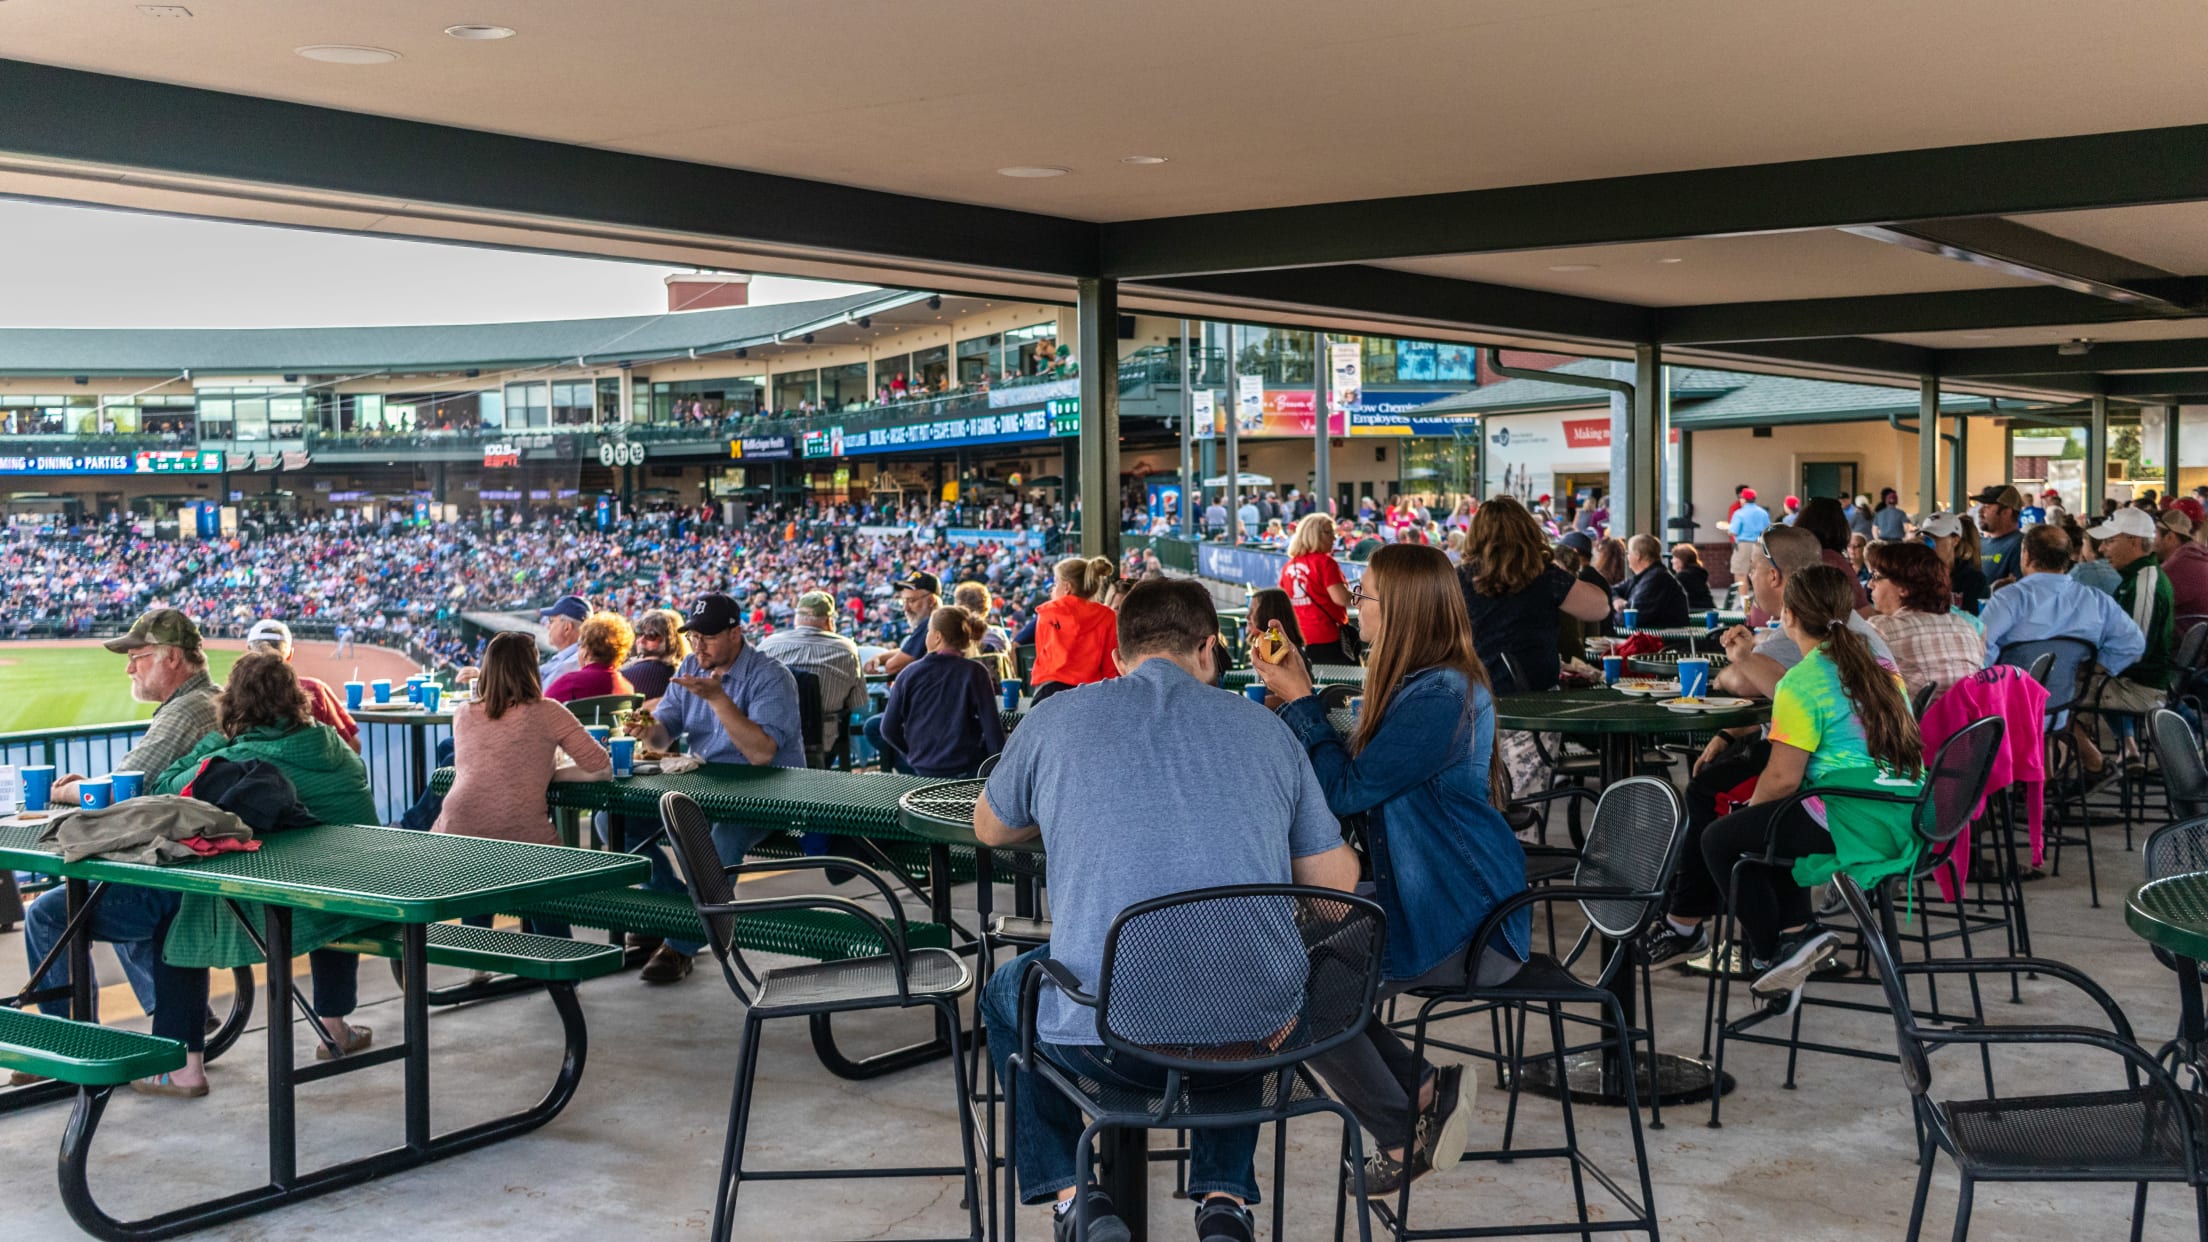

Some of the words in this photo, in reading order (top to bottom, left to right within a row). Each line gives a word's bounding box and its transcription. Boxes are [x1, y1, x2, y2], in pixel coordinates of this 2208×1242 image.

[1353, 403, 1376, 413] ow
[1353, 414, 1410, 426] Employees
[1574, 428, 1602, 441] Making
[604, 447, 610, 461] 2
[37, 456, 74, 470] DINING
[84, 455, 127, 469] PARTIES
[484, 455, 518, 467] ESPN
